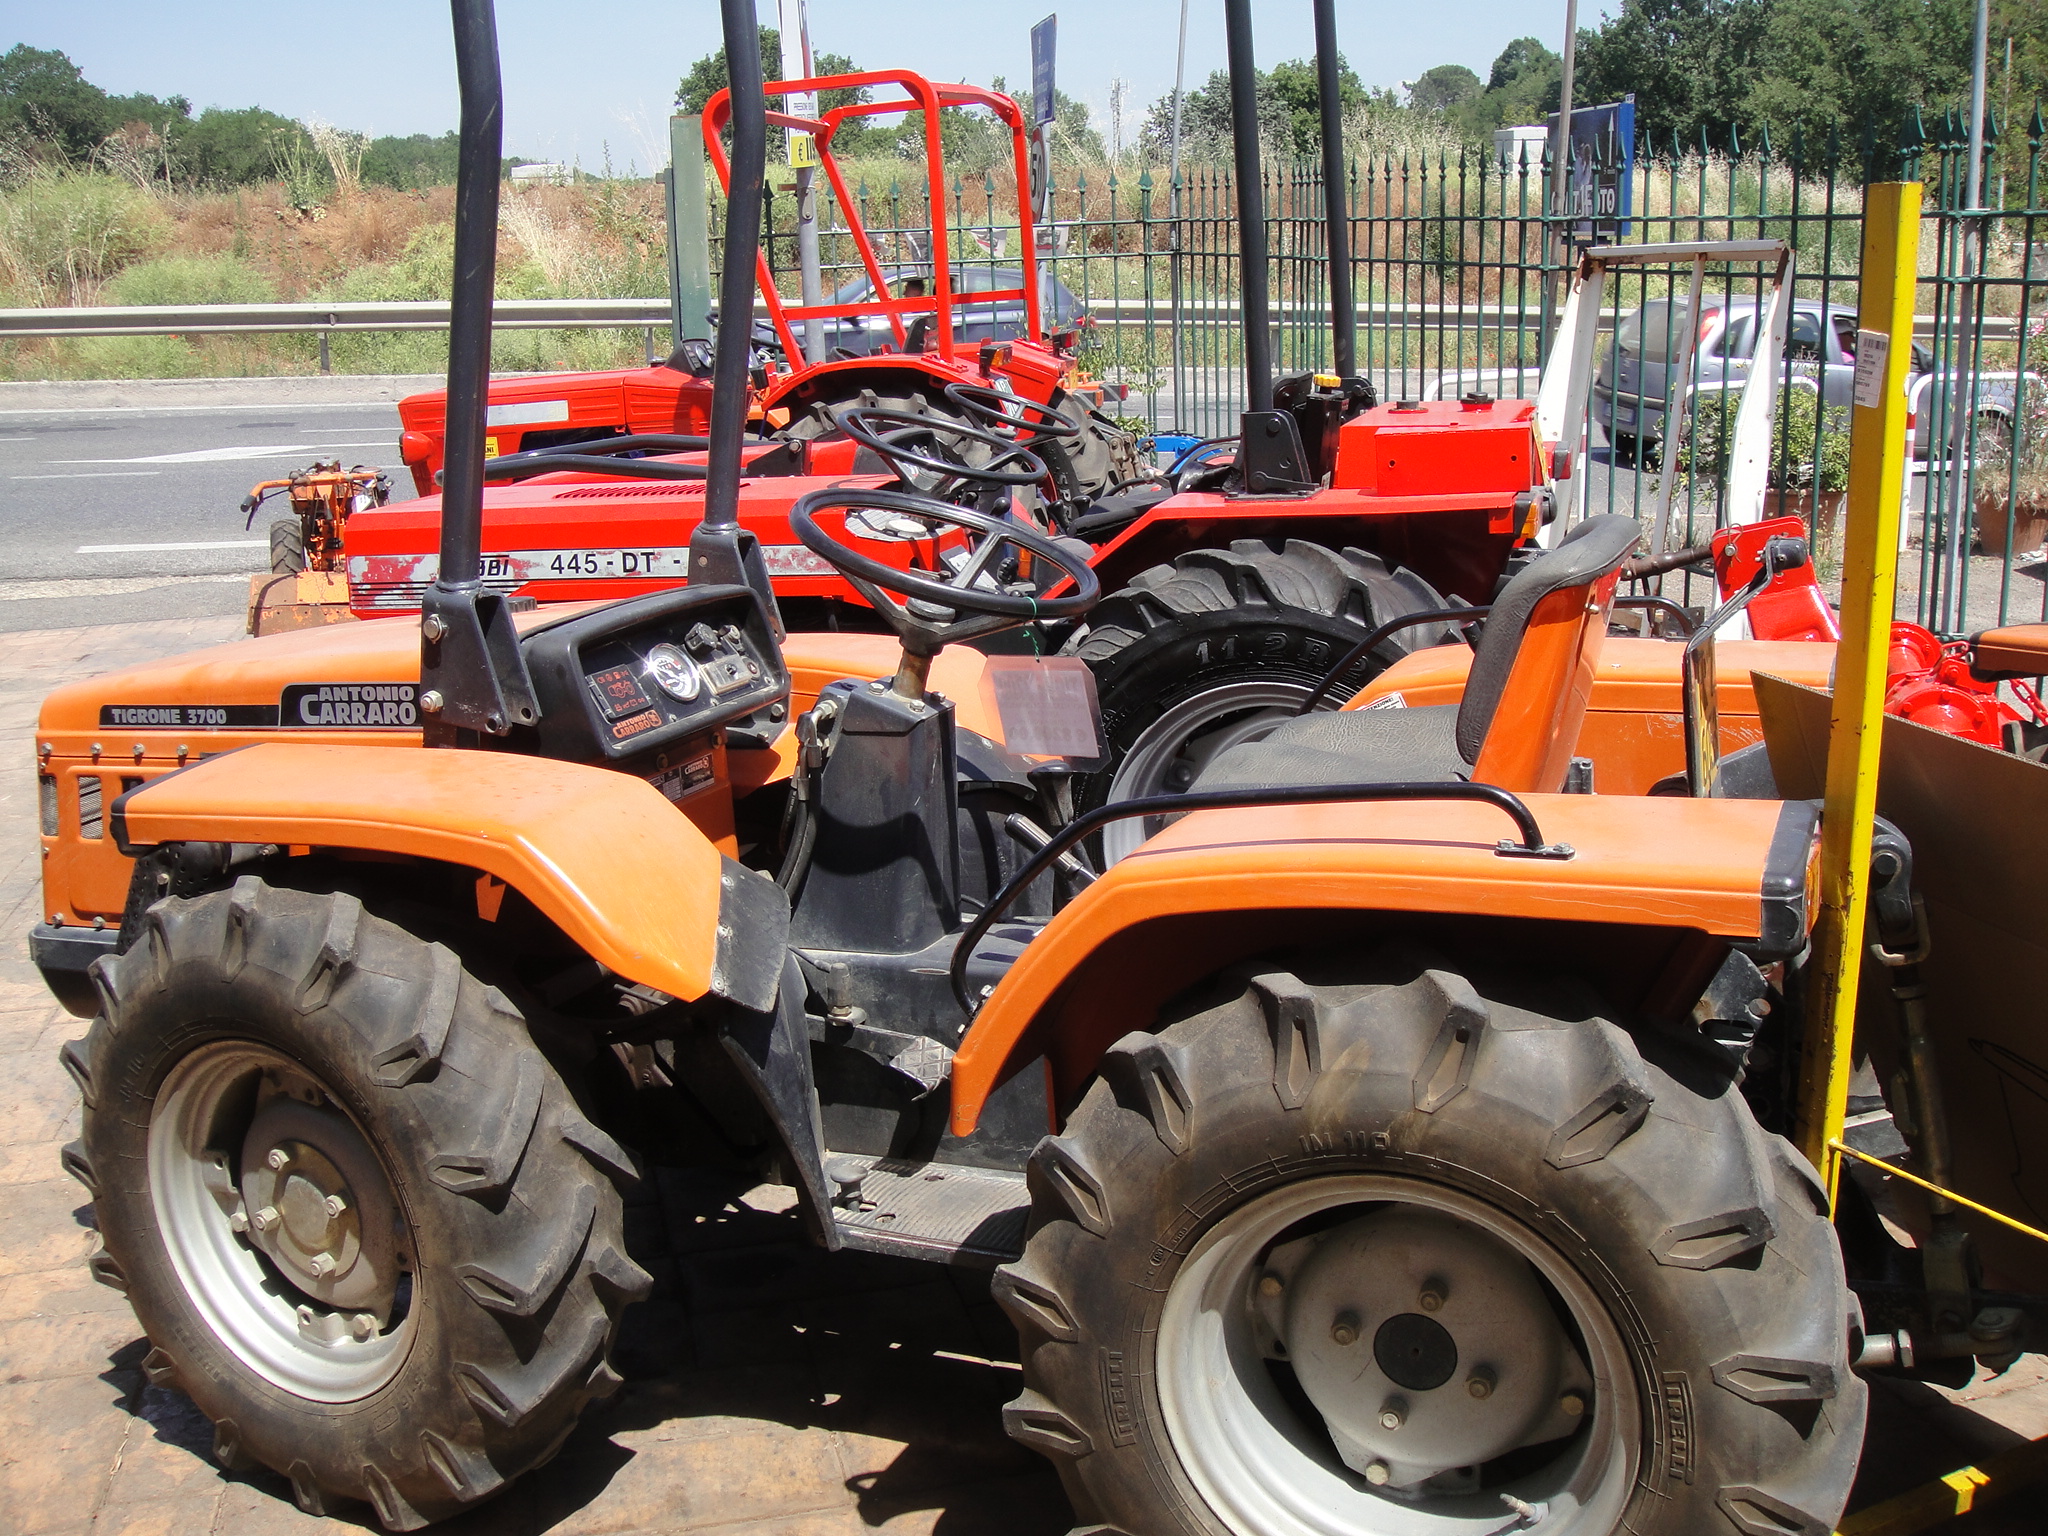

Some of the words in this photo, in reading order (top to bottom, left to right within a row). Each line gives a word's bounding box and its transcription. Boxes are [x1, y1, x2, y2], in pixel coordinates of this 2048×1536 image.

[550, 553, 599, 576] 445
[621, 551, 656, 574] DT
[318, 686, 416, 702] ANTONIO
[111, 708, 182, 725] TIGRONE
[187, 708, 228, 725] 3700
[299, 693, 417, 725] CARRARO
[612, 719, 651, 739] CARRARO
[1099, 1347, 1137, 1449] PIRELLI
[1662, 1370, 1698, 1486] PIRELLI
